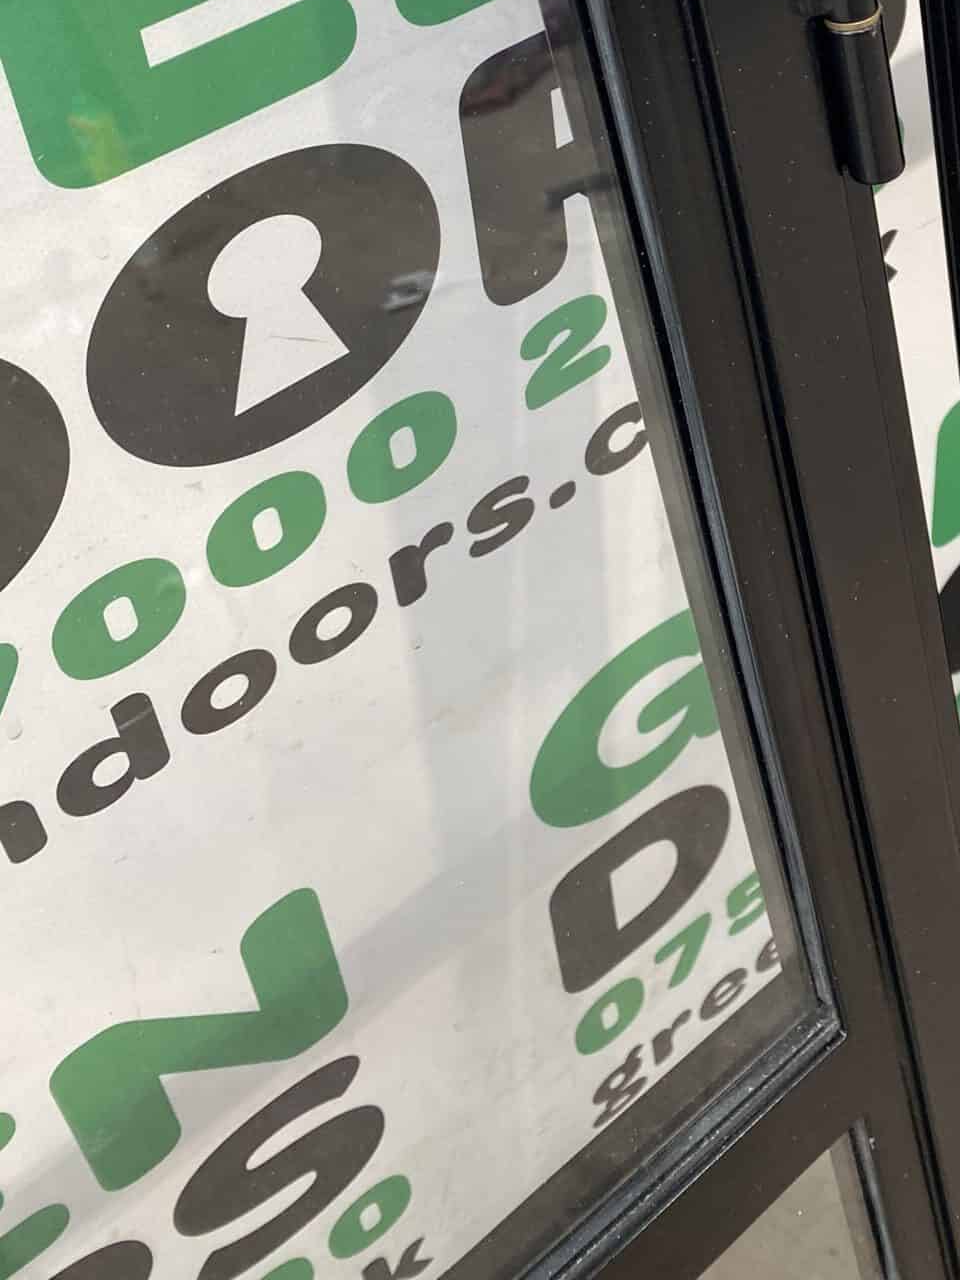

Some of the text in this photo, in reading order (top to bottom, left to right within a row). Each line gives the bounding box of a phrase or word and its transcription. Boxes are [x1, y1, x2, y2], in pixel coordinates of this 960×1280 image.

[0, 294, 612, 720] 000 2
[549, 784, 730, 994] D
